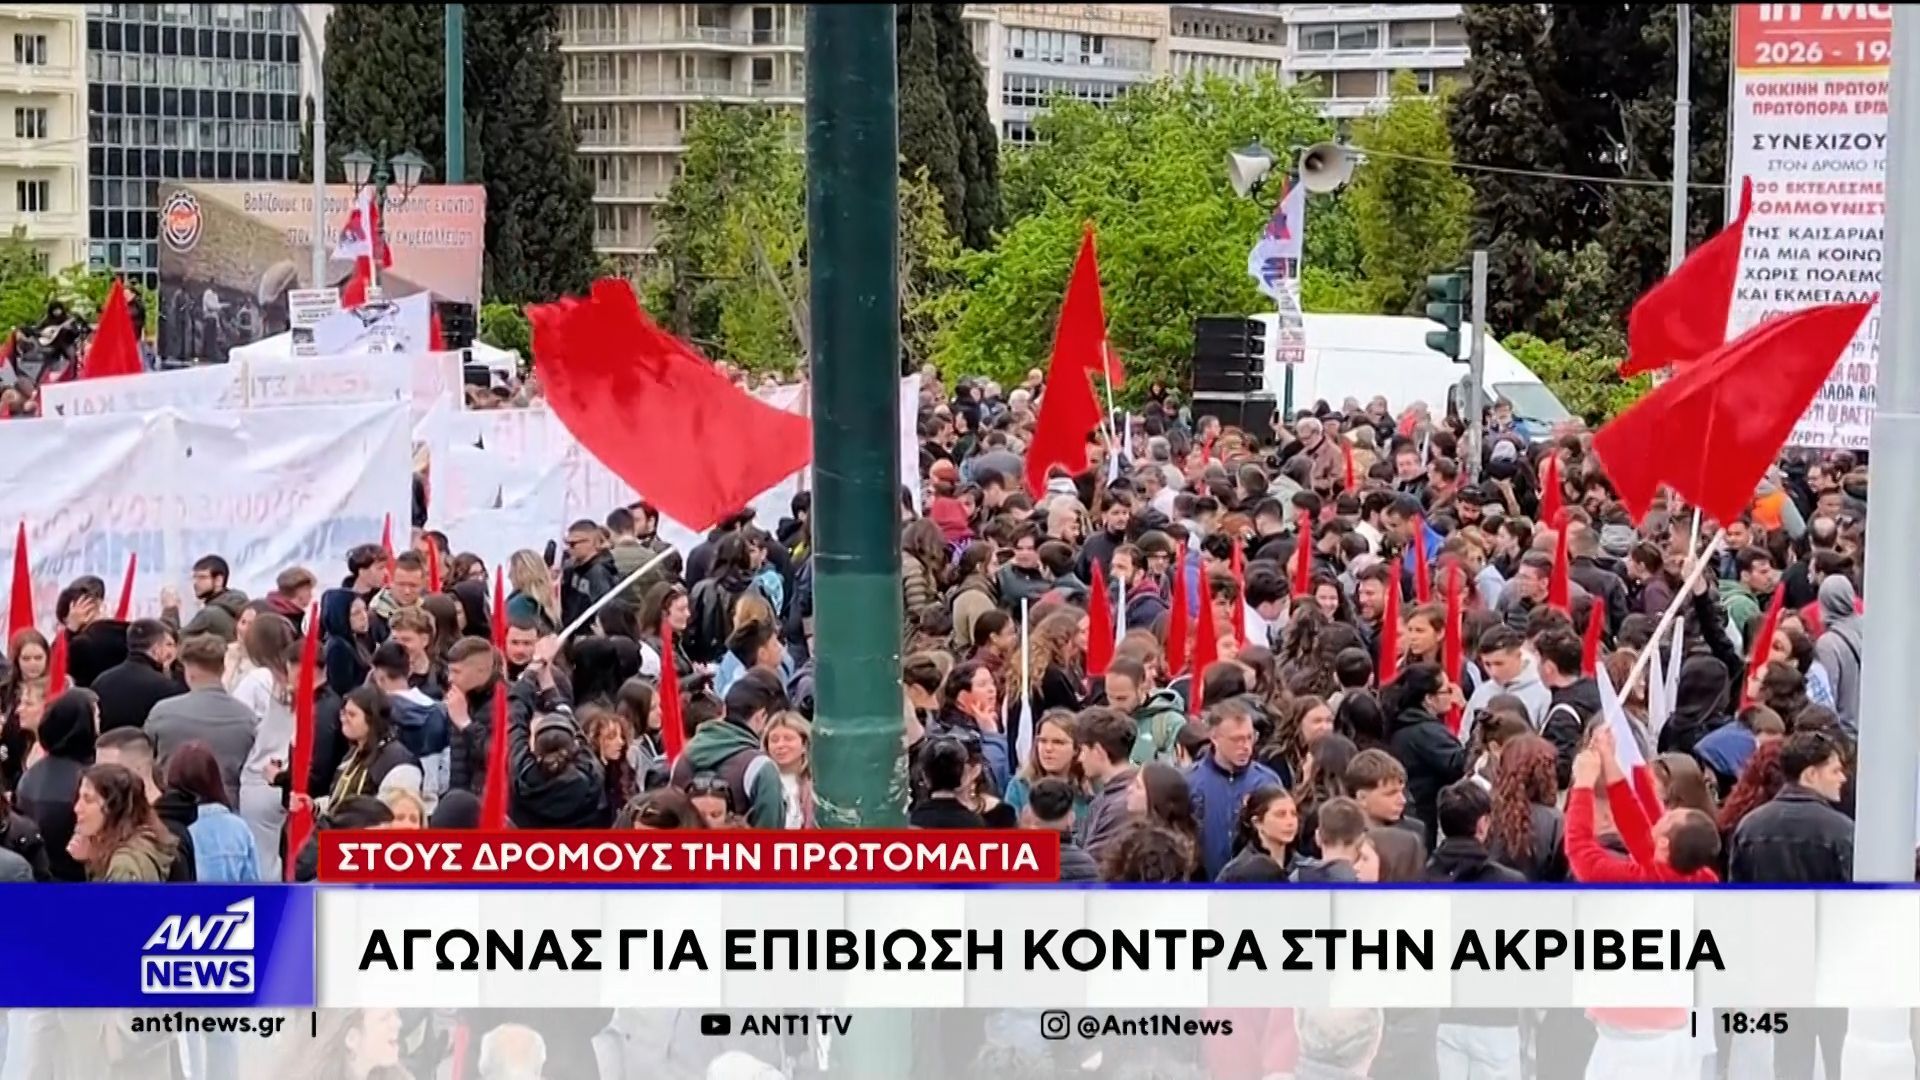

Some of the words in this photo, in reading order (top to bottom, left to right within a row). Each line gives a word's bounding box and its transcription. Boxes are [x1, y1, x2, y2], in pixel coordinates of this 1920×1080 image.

[1755, 41, 1823, 64] 2026
[1856, 40, 1891, 62] 19
[1745, 82, 1819, 97] ΚΟΚΚΙΝΗ
[1752, 101, 1849, 115] ΠΡΩΤΟΠΟΡΑ
[1752, 133, 1887, 150] ΣΥΝΕΧΙΖΟΥ
[1767, 159, 1808, 172] ΣΤΟΝ
[1811, 159, 1868, 172] ΔΡΟΜΟ
[1752, 181, 1779, 194] 00
[1748, 227, 1779, 240] ΤΗΣ
[1744, 248, 1770, 260] ΓΙΑ
[1777, 248, 1811, 260] ΜΙΑ
[1818, 249, 1881, 262] ΚΟΙΝΩ
[1745, 267, 1799, 281] ΧΩΡΙΣ
[1737, 288, 1767, 300] ΚΑΙ
